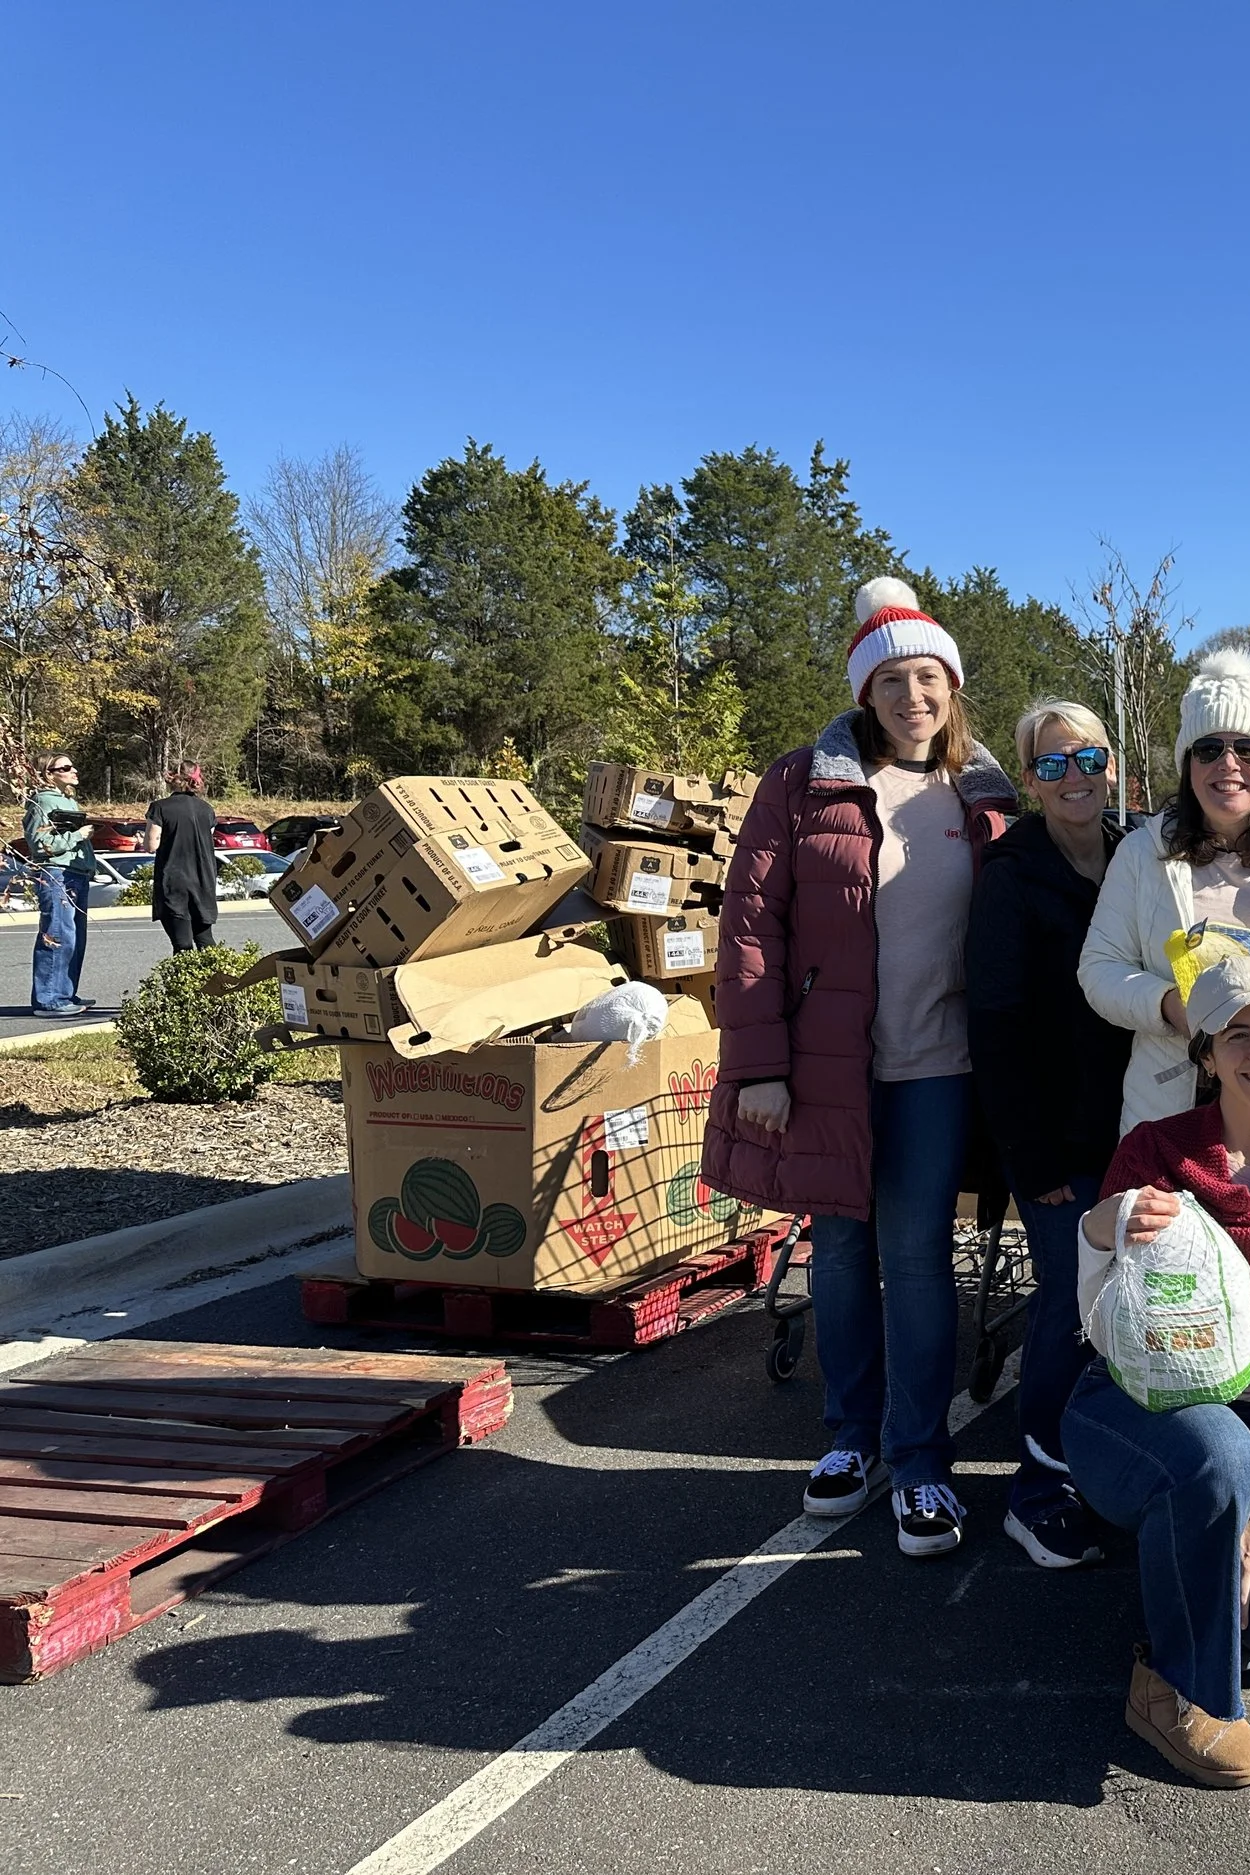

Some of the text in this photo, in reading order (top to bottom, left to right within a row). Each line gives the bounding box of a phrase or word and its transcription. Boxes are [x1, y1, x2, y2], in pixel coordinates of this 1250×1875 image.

[412, 808, 435, 832] PRODUCT
[422, 843, 443, 870] PRODUCT
[500, 858, 517, 868] READY
[517, 857, 525, 865] TO
[533, 848, 551, 859] TURKEY
[612, 849, 621, 875] PRODUCT
[333, 886, 350, 903] READY
[354, 867, 369, 885] COOK
[367, 849, 386, 869] TURKEY
[335, 886, 389, 949] READY TO COOK TURKEY
[640, 917, 649, 943] PRODUCT
[342, 1011, 358, 1019] TURKEY
[366, 1057, 525, 1111] Watermelons
[369, 1111, 400, 1120] PRODUCT
[419, 1113, 434, 1121] USA
[441, 1114, 469, 1122] MEXICO
[573, 1220, 625, 1234] WATCH
[580, 1235, 617, 1247] STEP
